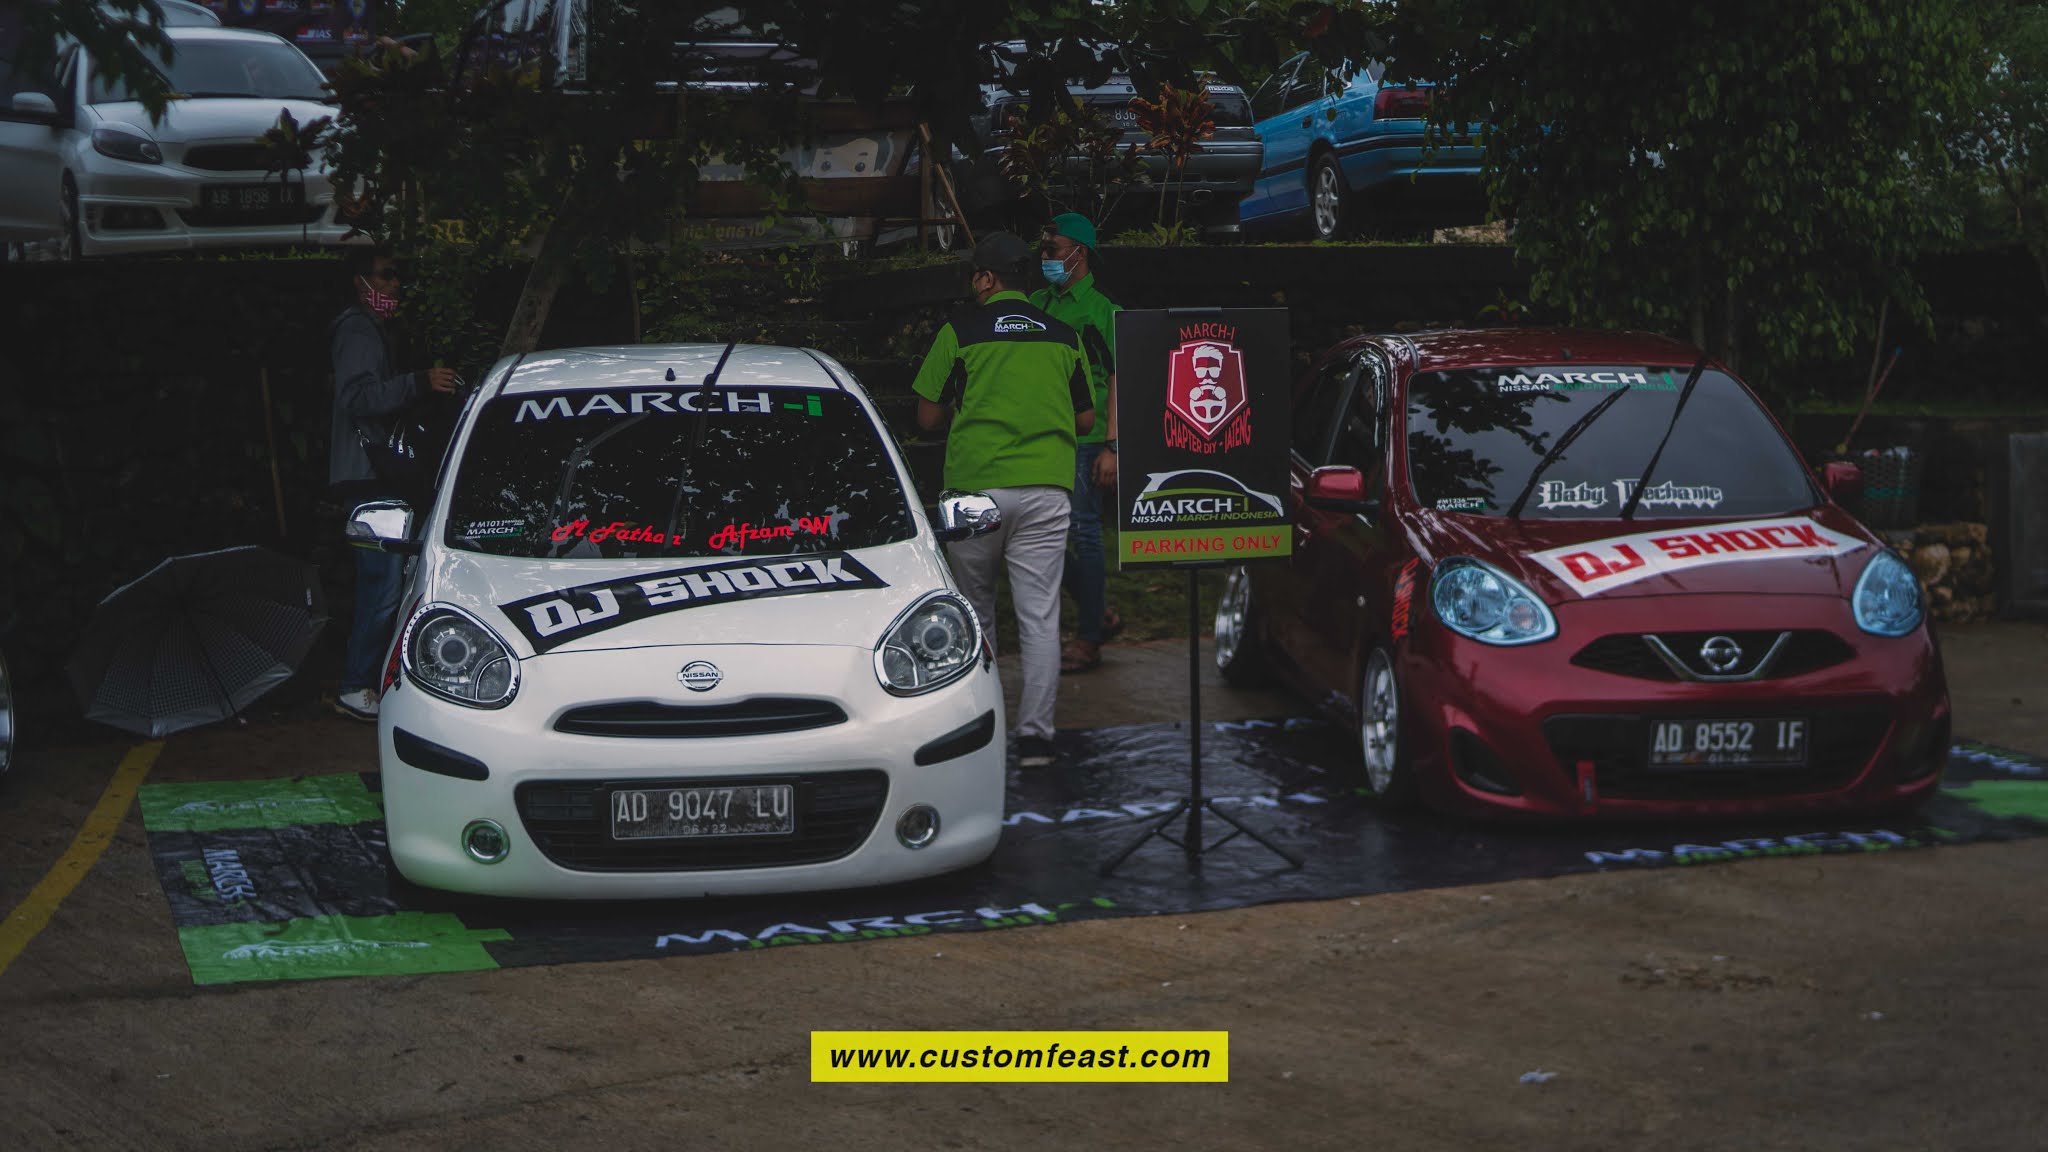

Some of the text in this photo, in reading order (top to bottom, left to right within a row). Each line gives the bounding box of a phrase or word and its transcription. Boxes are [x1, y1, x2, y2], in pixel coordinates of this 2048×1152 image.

[1179, 322, 1236, 340] MARCH-I
[1500, 384, 1550, 392] NISSAN
[1164, 409, 1202, 454] CHAPTER
[1203, 441, 1217, 454] DIY
[1132, 496, 1248, 516] MARCH-I
[1543, 481, 1607, 508] Baby
[551, 518, 591, 543] M
[798, 515, 832, 536] W
[1131, 511, 1279, 523] NISSAN MARCH INDONESIA
[1131, 535, 1281, 555] PARKING ONLY
[1557, 525, 1837, 583] DJ SHOCK
[523, 557, 863, 638] DJ SHOCK
[1654, 721, 1804, 752] AD 8552 IF
[616, 787, 789, 823] AD 9047 LU
